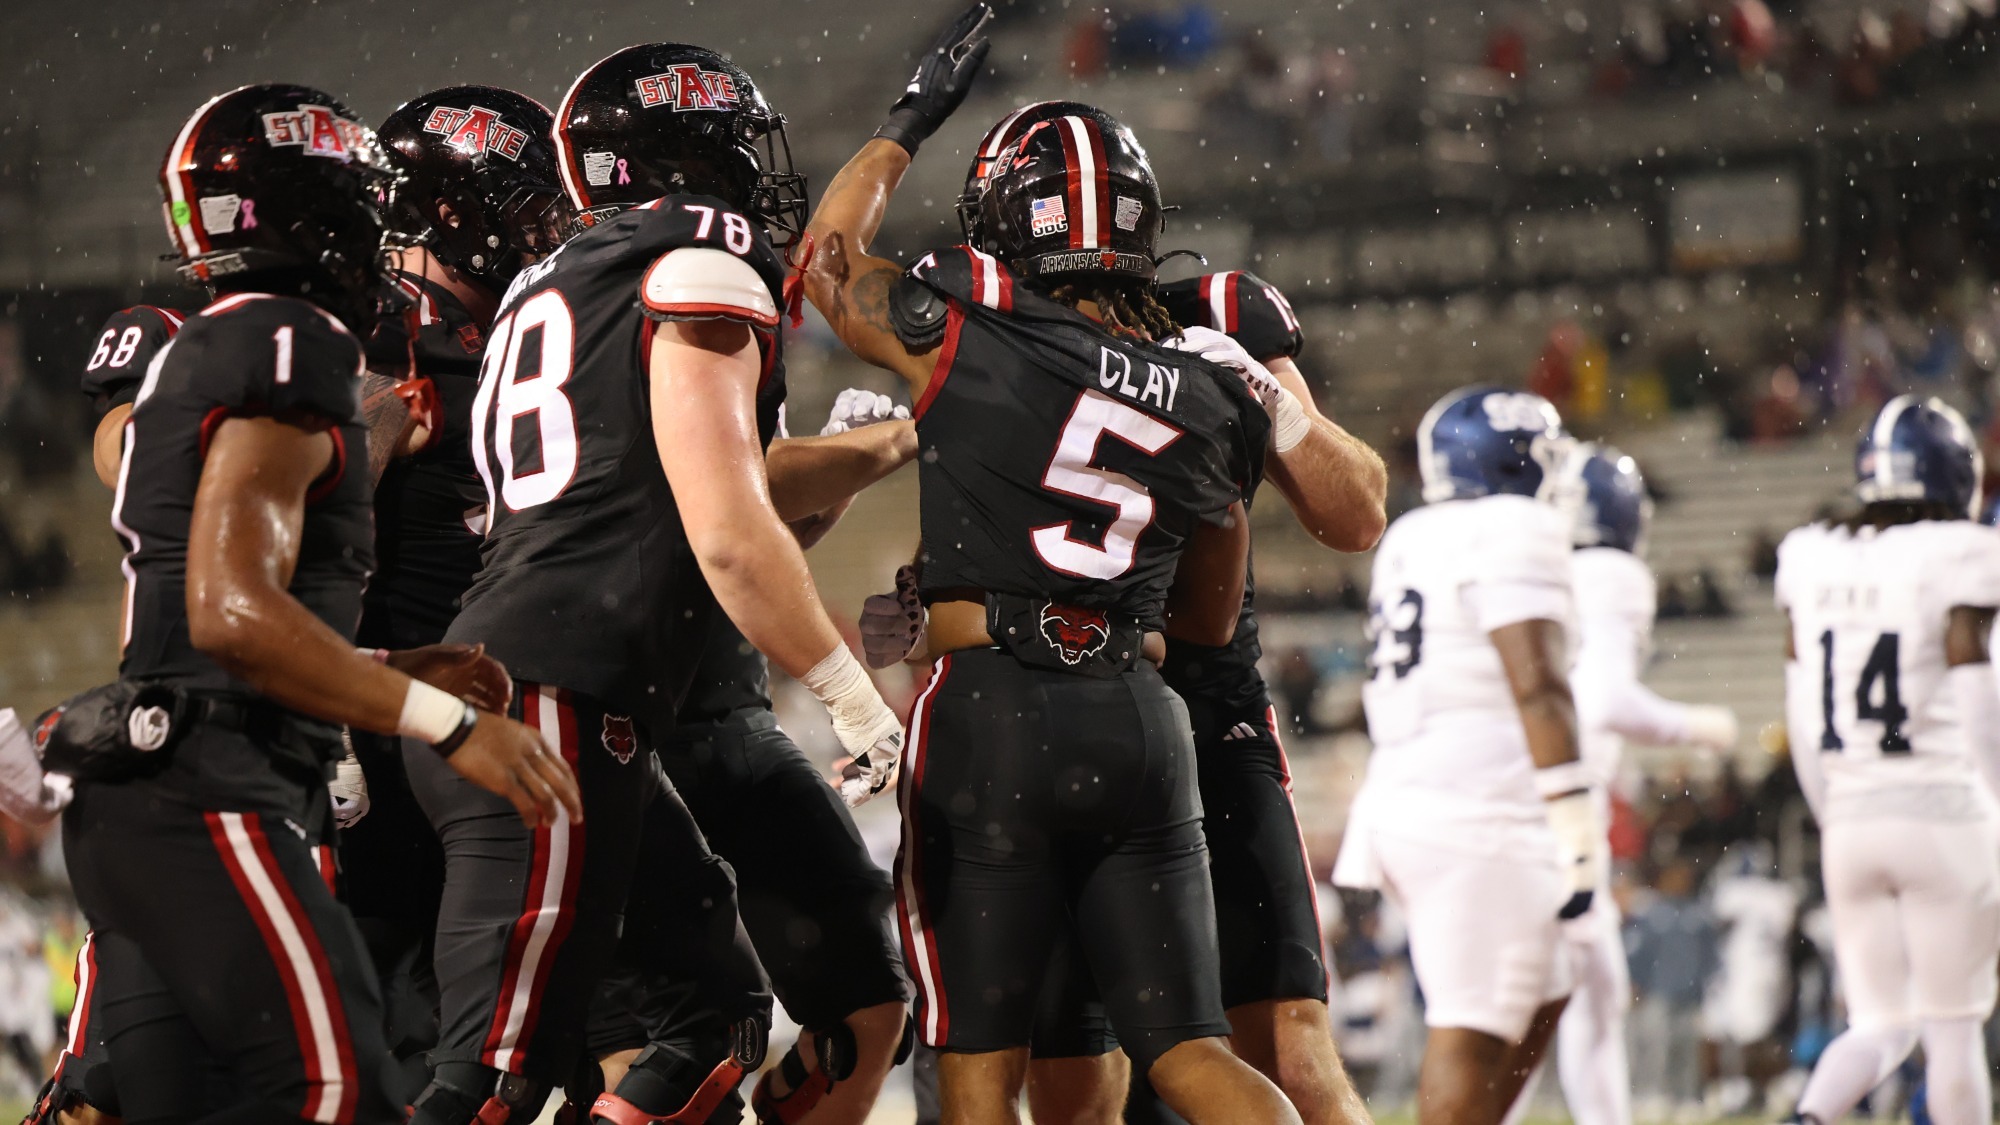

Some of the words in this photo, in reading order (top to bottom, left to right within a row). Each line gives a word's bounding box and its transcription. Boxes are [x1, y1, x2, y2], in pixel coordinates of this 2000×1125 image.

[635, 63, 741, 113] STATE
[423, 105, 529, 161] STATE
[682, 204, 752, 256] 78
[1039, 252, 1101, 275] ARKANSAS
[86, 326, 143, 372] 68
[270, 325, 295, 384] 1
[1100, 345, 1180, 413] CLAY
[471, 287, 581, 540] 78
[1029, 387, 1186, 581] 5
[1820, 628, 1912, 755] 14
